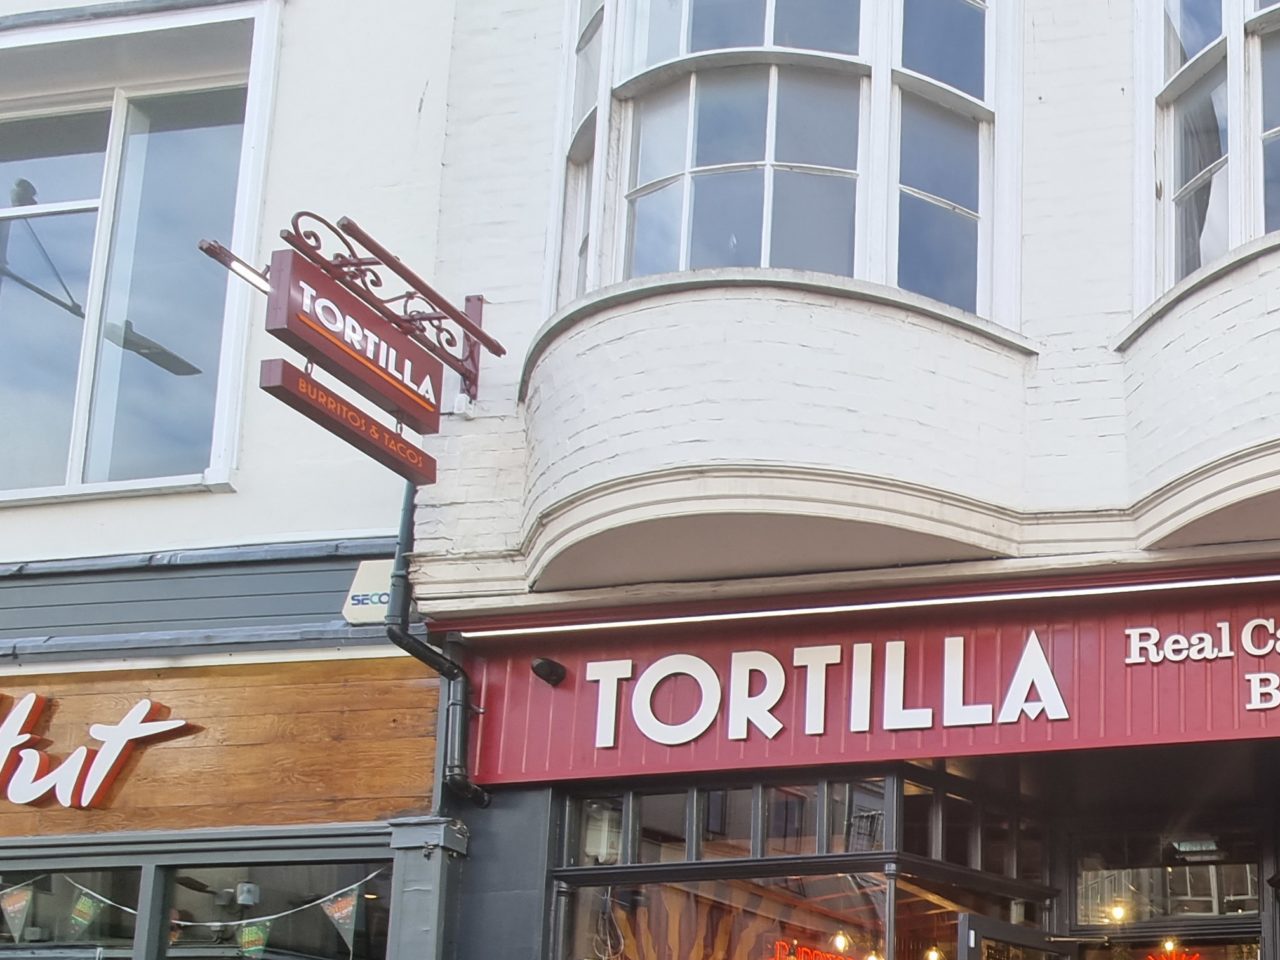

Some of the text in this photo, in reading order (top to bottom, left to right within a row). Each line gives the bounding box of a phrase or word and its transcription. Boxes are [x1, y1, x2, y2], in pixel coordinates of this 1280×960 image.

[299, 281, 436, 404] TORTILLA
[299, 378, 423, 467] BURRITOS & TACOS
[586, 630, 1069, 748] TORTILLA
[1125, 622, 1234, 664] Real
